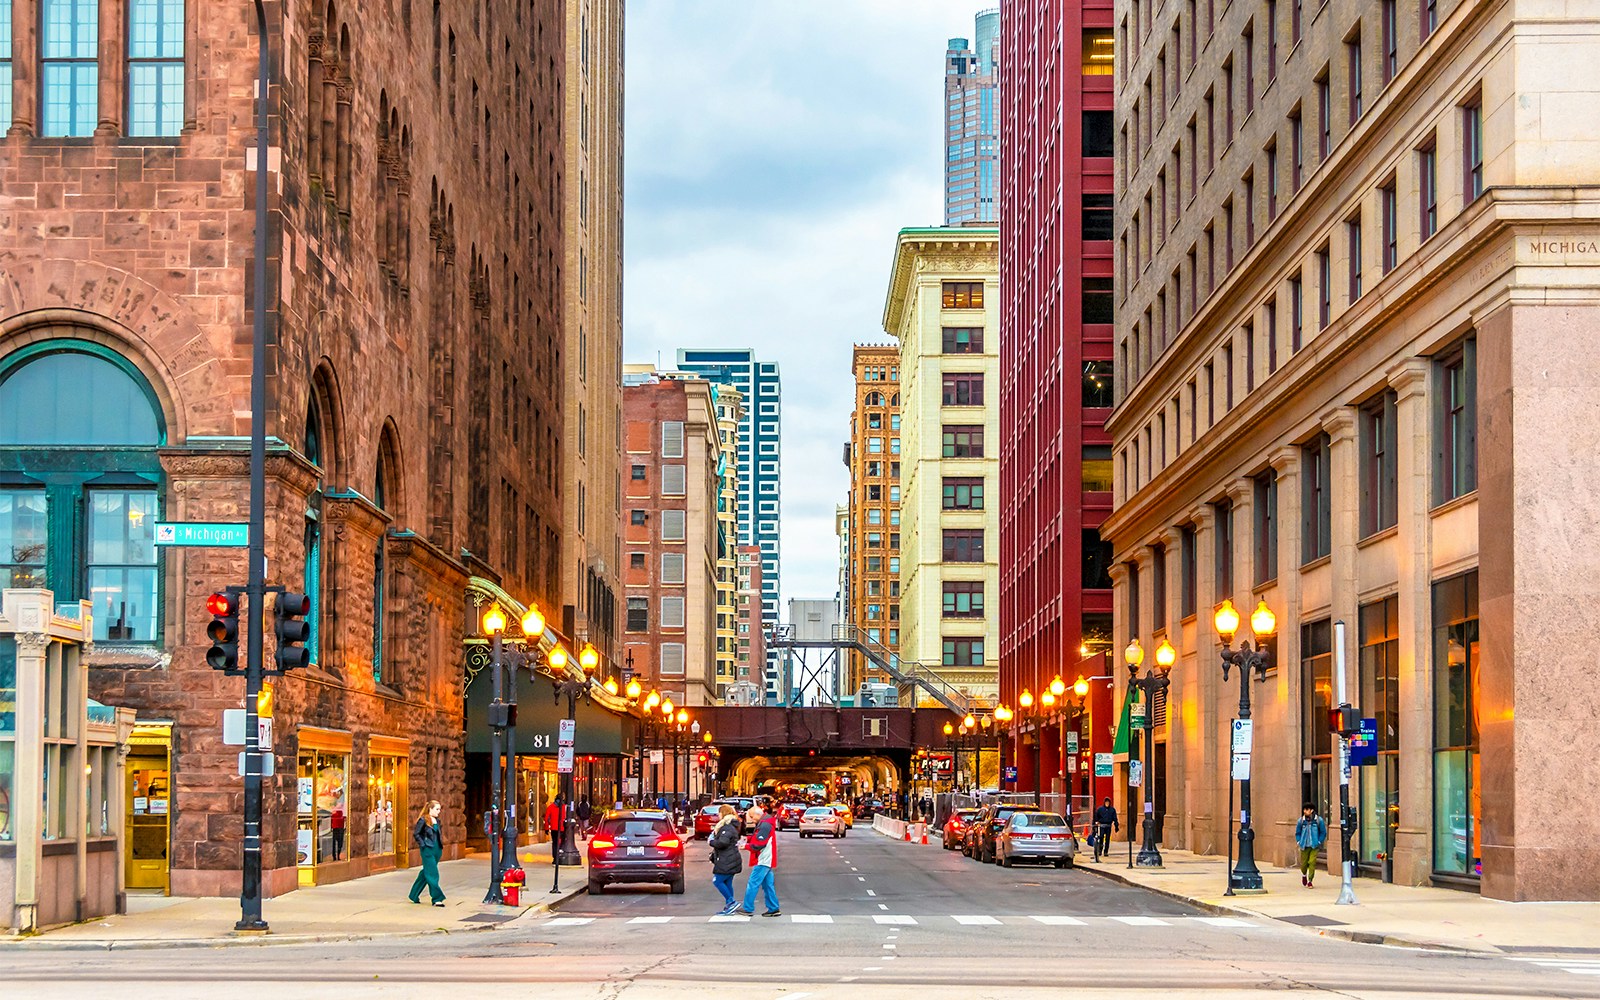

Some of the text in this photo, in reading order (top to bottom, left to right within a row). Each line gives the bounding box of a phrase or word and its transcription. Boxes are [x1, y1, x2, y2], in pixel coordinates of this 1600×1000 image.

[178, 529, 183, 537] S
[185, 527, 234, 544] Michigan
[533, 734, 550, 748] 81
